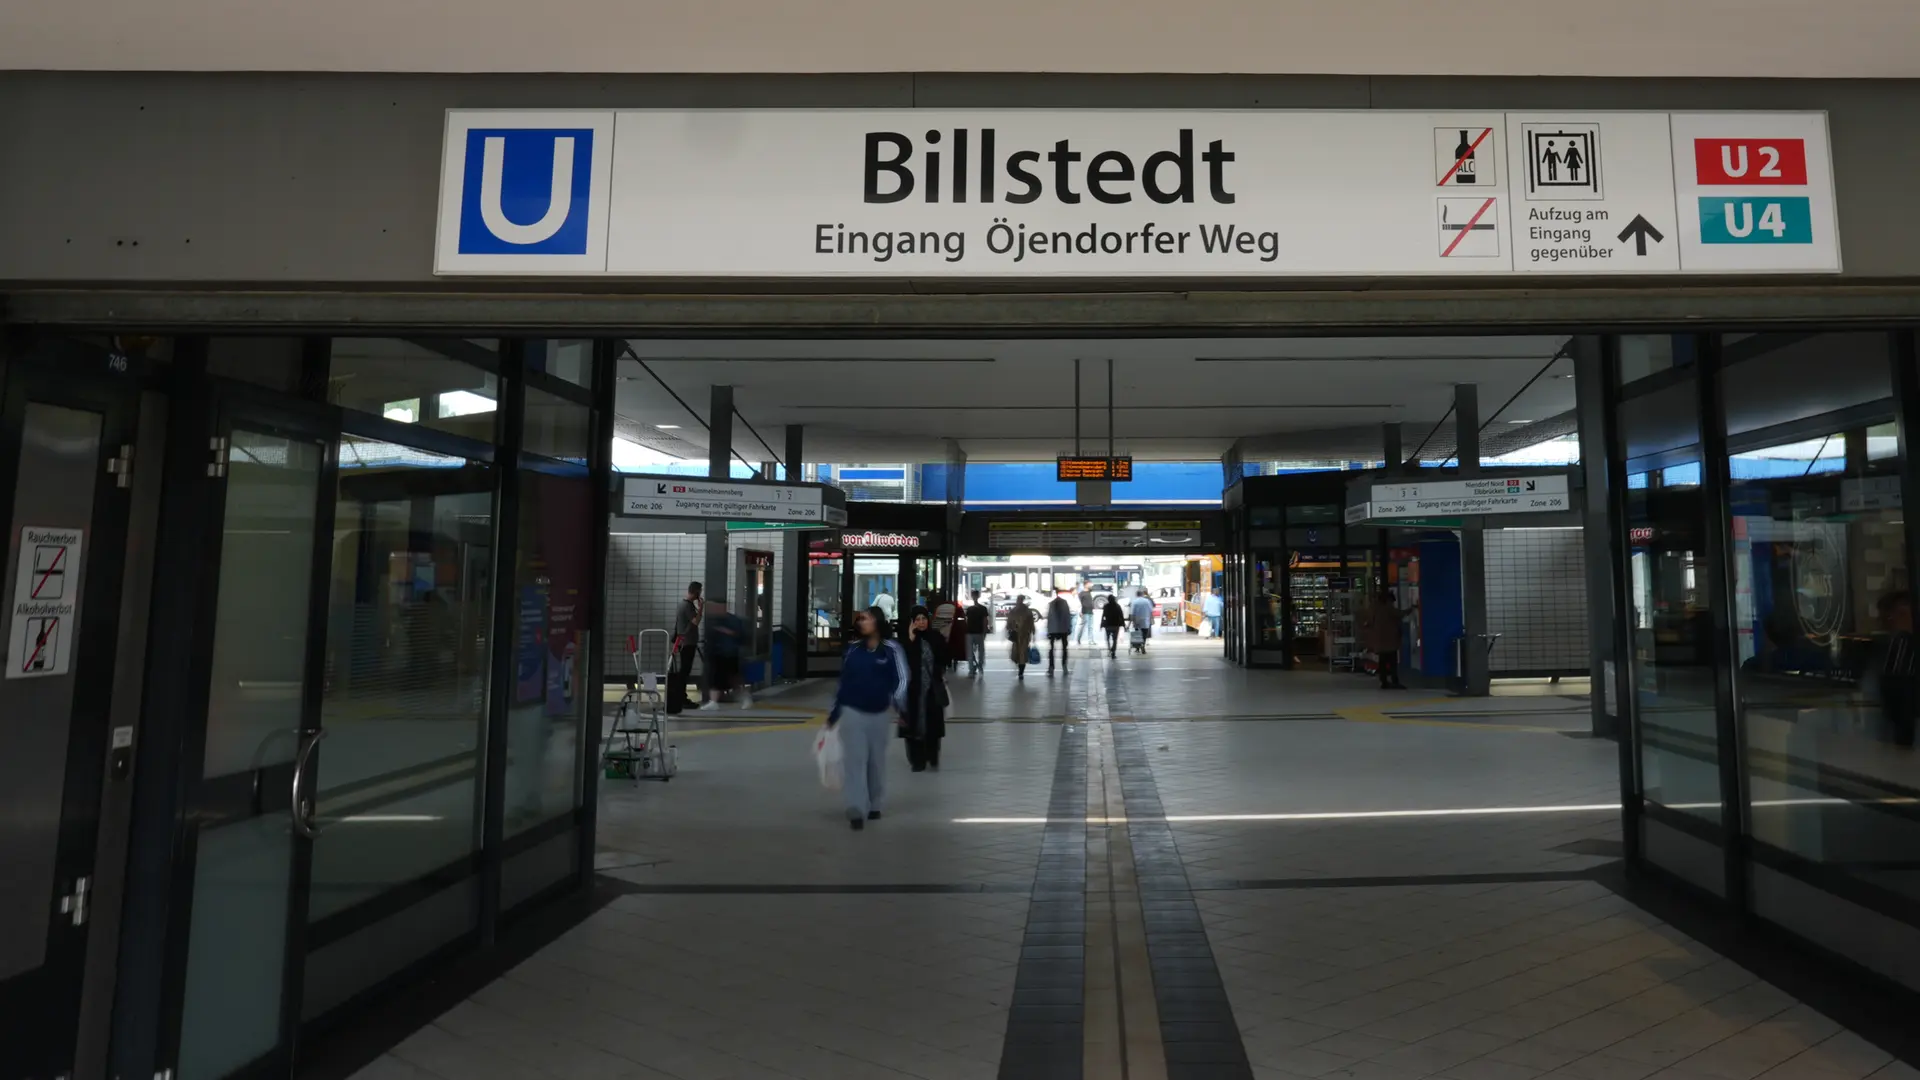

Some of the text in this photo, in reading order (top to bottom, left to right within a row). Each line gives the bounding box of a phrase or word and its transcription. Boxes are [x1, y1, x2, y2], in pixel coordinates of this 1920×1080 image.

[864, 128, 1236, 205] Billstedt
[480, 136, 575, 244] U
[1528, 207, 1609, 224] Aufzug am
[1724, 203, 1786, 238] U4
[815, 217, 1279, 263] Eingang Öjendorfer Weg
[1529, 226, 1591, 243] Eingang
[1530, 244, 1614, 262] gegenüber
[109, 354, 128, 371] 746
[650, 502, 663, 510] 206
[675, 500, 700, 509] Zugang
[712, 501, 723, 509] mit
[724, 502, 747, 511] gültiger
[748, 503, 777, 511] Fahrkarte
[1417, 501, 1440, 509] Zugang
[1487, 497, 1518, 505] Fahrkarte
[28, 531, 77, 545] Rauchverbot
[842, 531, 920, 547] von Allwörden
[16, 602, 72, 616] Alkoholverbot
